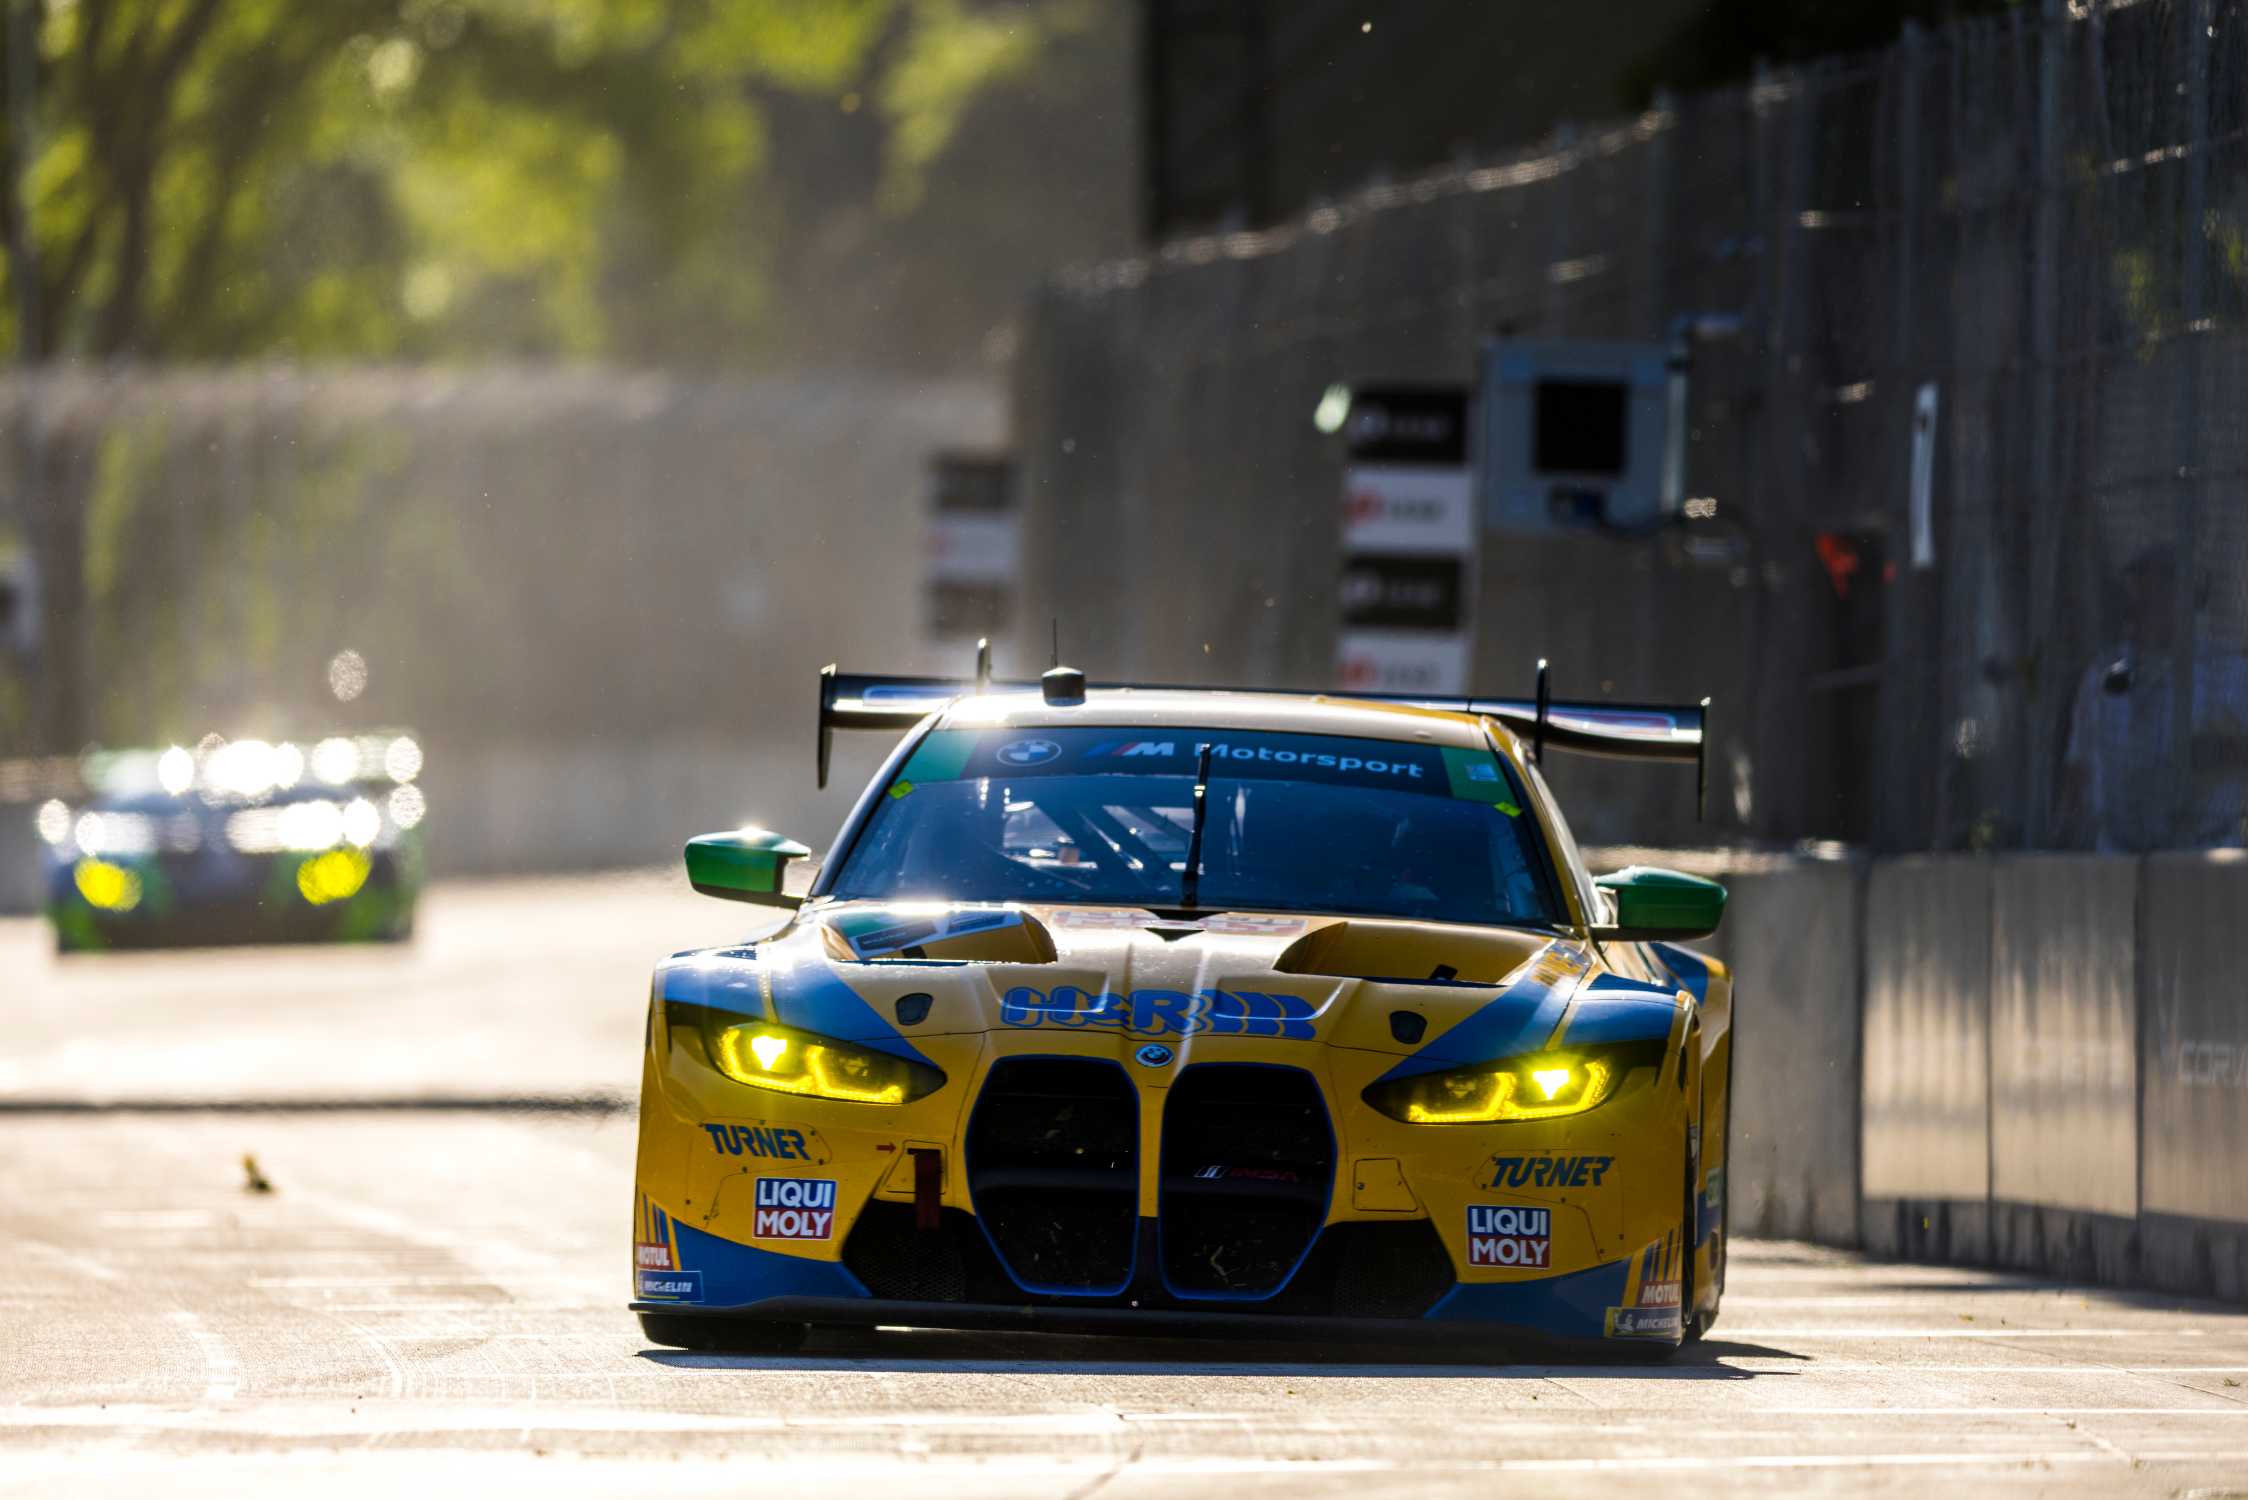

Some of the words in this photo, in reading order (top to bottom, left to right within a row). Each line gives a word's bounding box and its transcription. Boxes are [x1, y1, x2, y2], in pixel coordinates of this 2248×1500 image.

[1194, 743, 1424, 778] Motorsport
[704, 1123, 811, 1160] TURNER
[1491, 1156, 1612, 1188] TURNER
[758, 1180, 833, 1208] LIQUI
[757, 1210, 832, 1236] MOLY
[1471, 1208, 1547, 1236] LIQUI
[1472, 1237, 1549, 1265] MOLY
